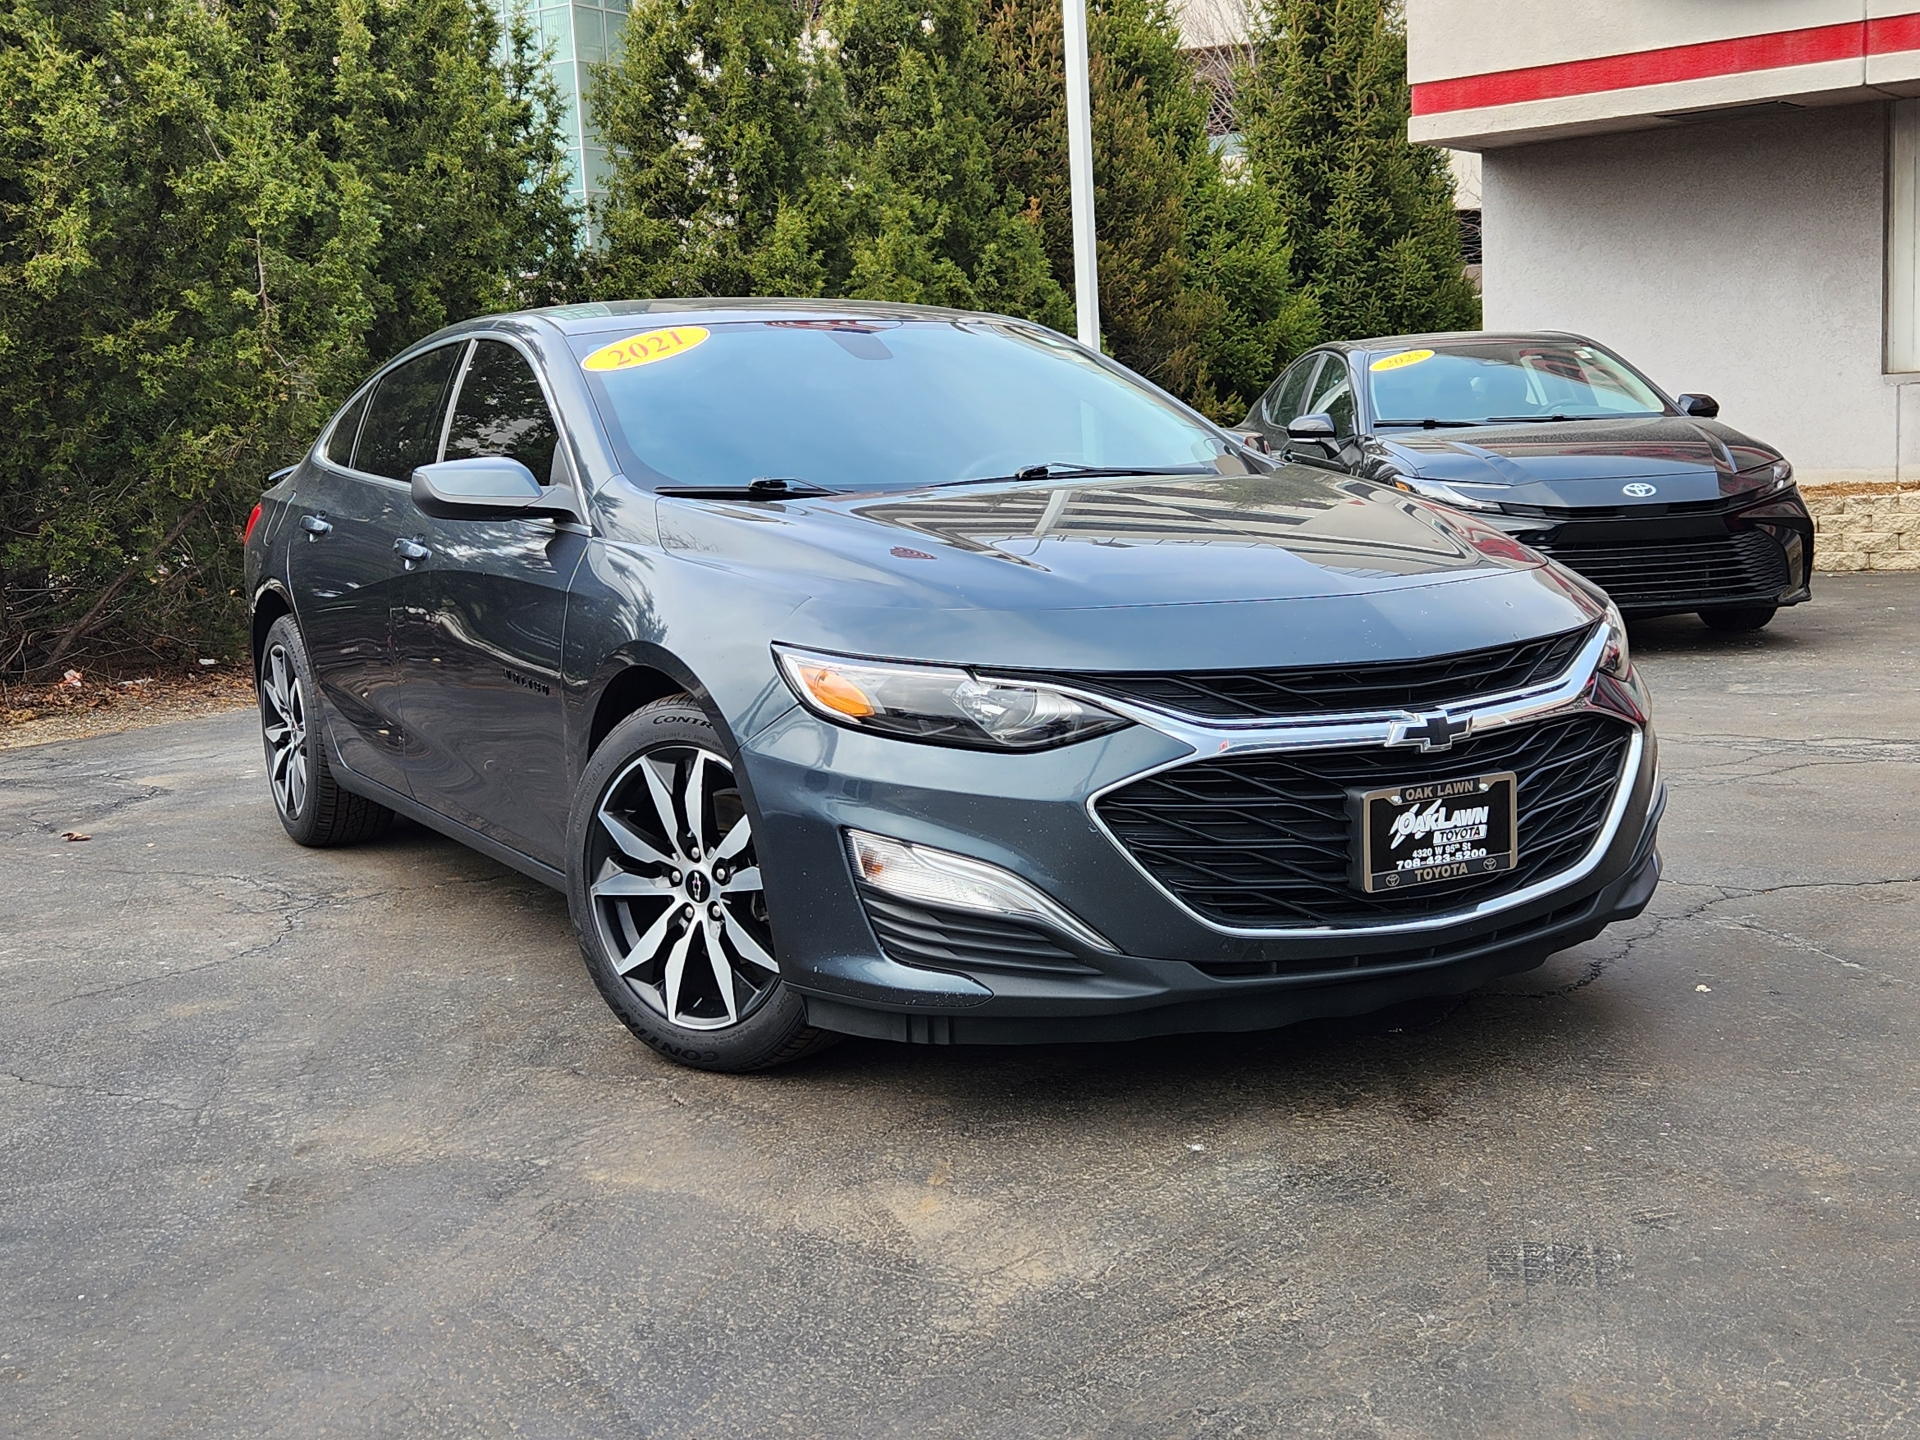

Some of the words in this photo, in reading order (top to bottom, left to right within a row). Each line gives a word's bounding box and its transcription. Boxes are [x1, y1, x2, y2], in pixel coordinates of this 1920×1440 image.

[607, 330, 686, 366] 2021
[1386, 352, 1423, 368] 2025
[1405, 786, 1433, 801] OAK
[1437, 780, 1474, 797] LAWN
[1439, 826, 1481, 843] TOYOTA
[1396, 848, 1487, 871] 708-423-5200
[1412, 847, 1433, 859] 4320
[1434, 846, 1444, 855] W
[1461, 842, 1472, 851] St
[1415, 862, 1469, 883] TOYOTA
